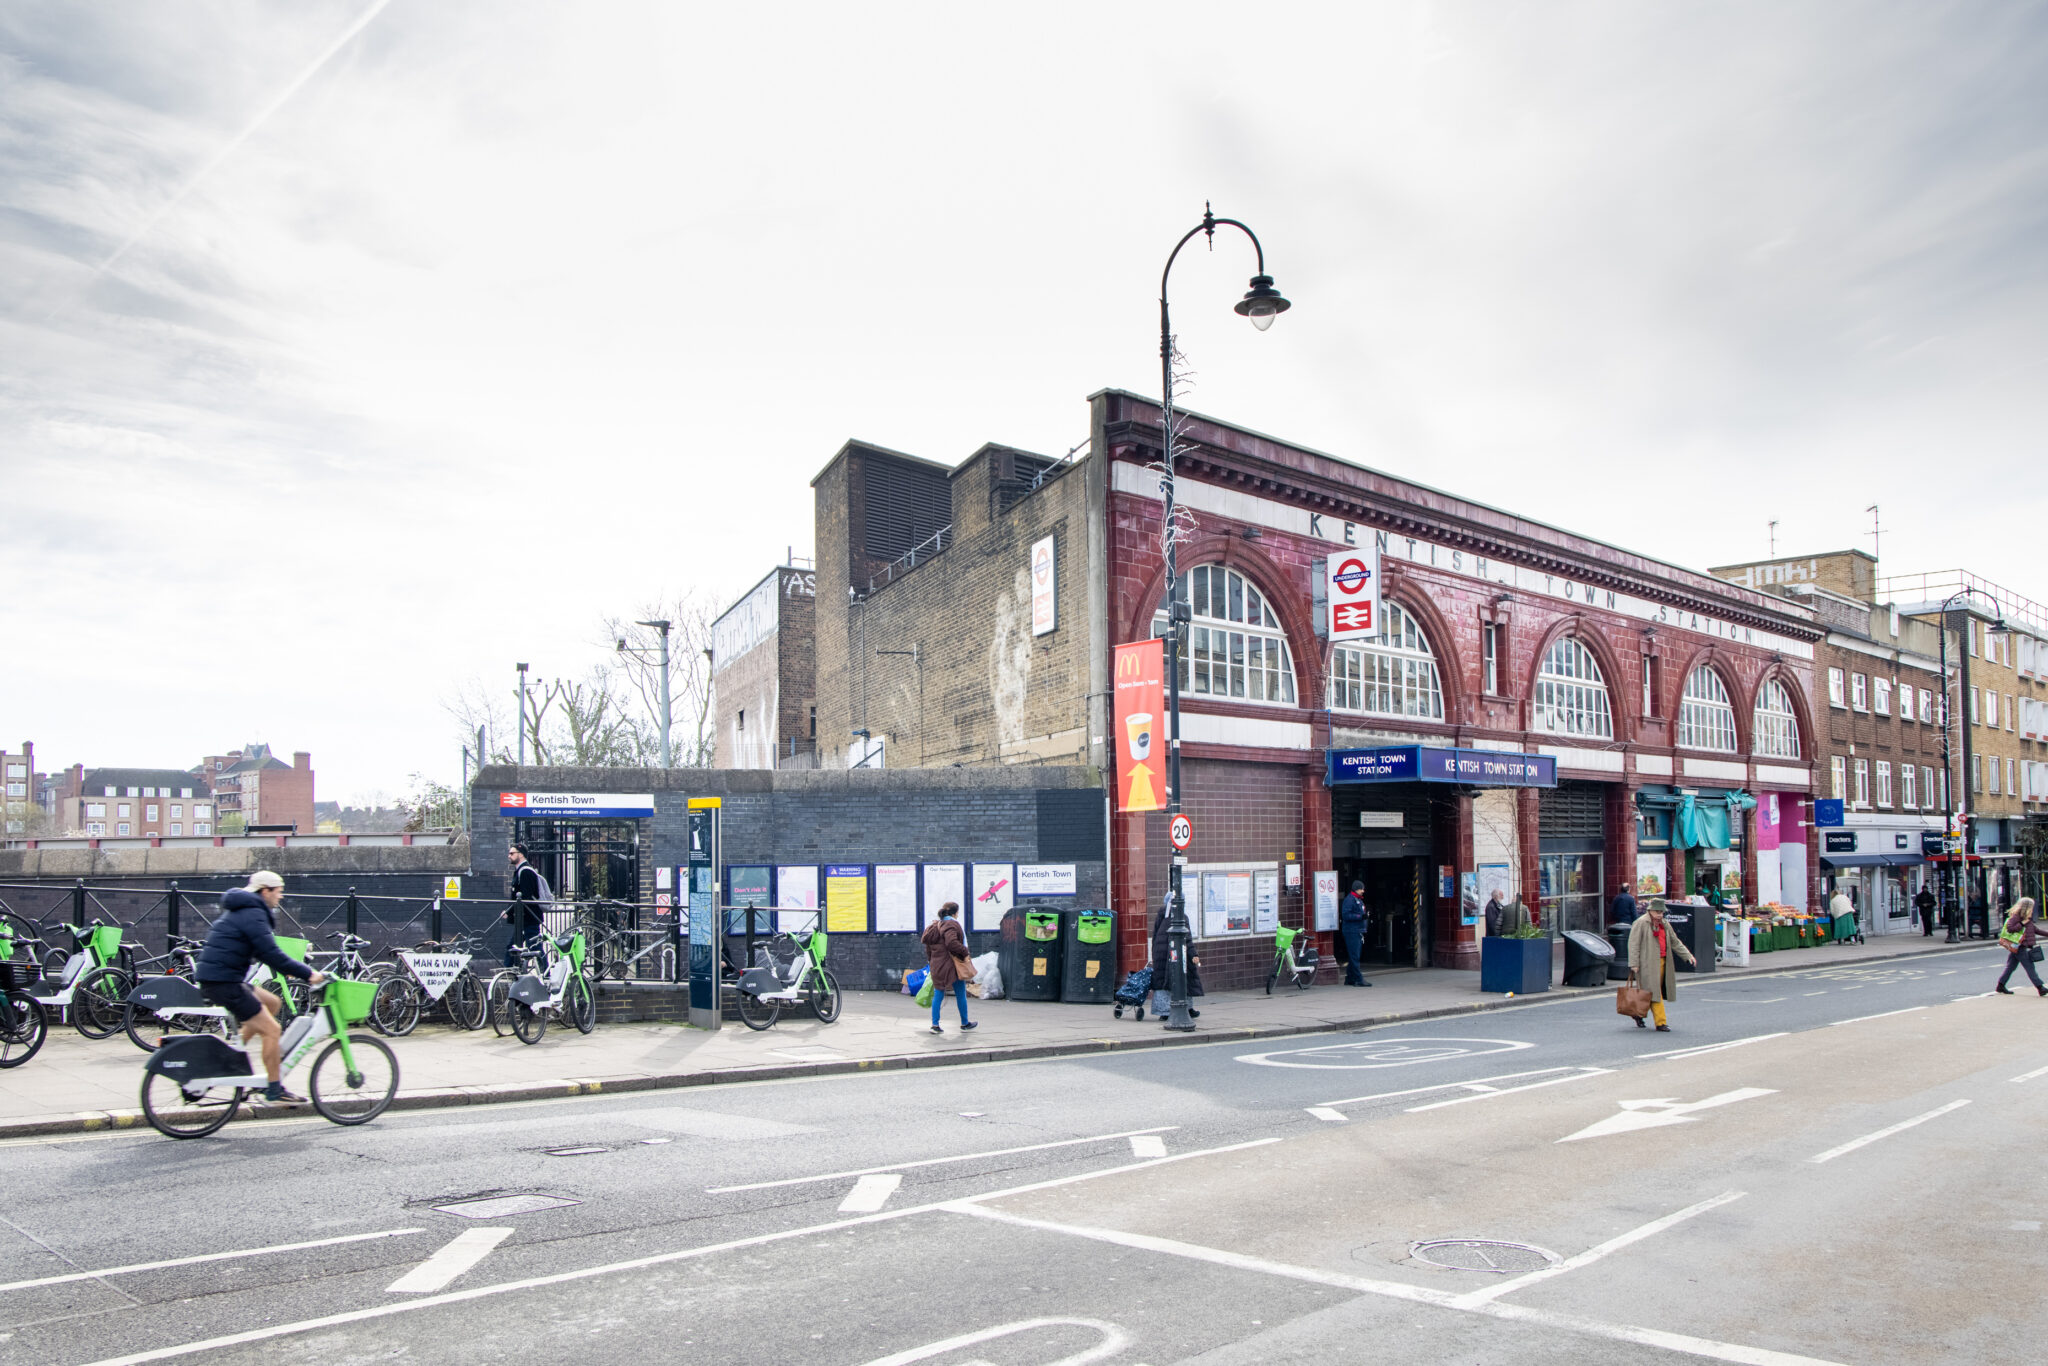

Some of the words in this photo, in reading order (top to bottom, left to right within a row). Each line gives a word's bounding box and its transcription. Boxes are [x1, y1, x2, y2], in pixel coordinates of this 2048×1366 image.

[1310, 512, 1487, 578] KENTISH
[1545, 574, 1615, 610] TOWN
[1660, 605, 1752, 643] STATION
[1334, 571, 1370, 582] UNDERGROUND
[1342, 756, 1376, 766] KENTISH
[1380, 754, 1406, 764] TOWN
[1357, 765, 1392, 775] STATION
[1484, 761, 1508, 775] TOWN
[1508, 763, 1538, 777] STATON
[532, 795, 569, 804] Kentish
[571, 795, 595, 805] Town
[1173, 824, 1190, 839] 20
[1021, 870, 1050, 878] Kentish
[1052, 870, 1072, 878] Town
[413, 959, 433, 968] MAN
[434, 960, 440, 968] &
[442, 959, 460, 968] VAN
